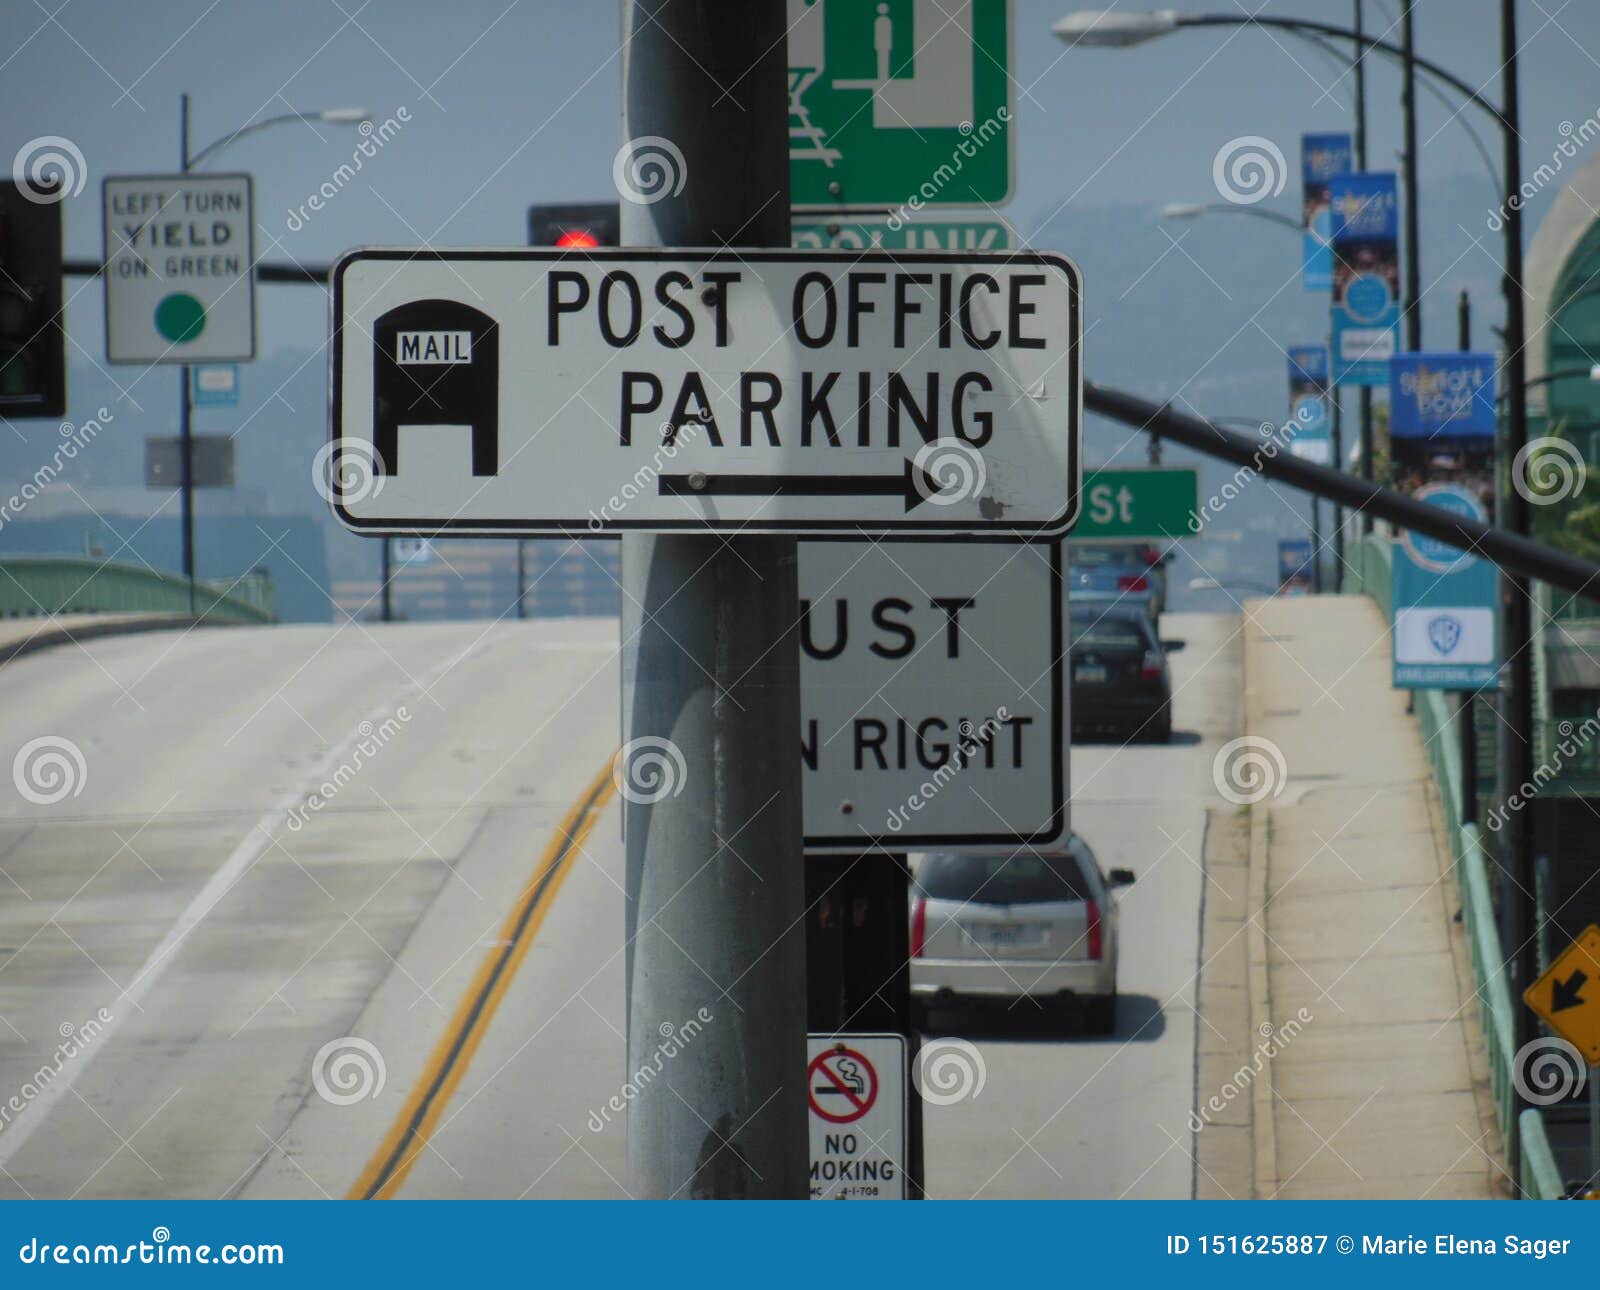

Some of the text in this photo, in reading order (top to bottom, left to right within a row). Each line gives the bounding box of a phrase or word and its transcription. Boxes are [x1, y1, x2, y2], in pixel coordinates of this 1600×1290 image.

[112, 190, 242, 215] LEFT TURN
[123, 221, 231, 248] YIELD
[119, 254, 240, 279] ON GREEN
[548, 271, 1046, 350] POST OFFICE
[401, 334, 471, 361] MAIL
[620, 371, 993, 449] PARKING
[1089, 484, 1133, 524] St
[800, 597, 976, 661] UST
[853, 716, 1034, 772] RIGHT
[825, 1134, 857, 1155] NO
[810, 1160, 894, 1181] MOKING
